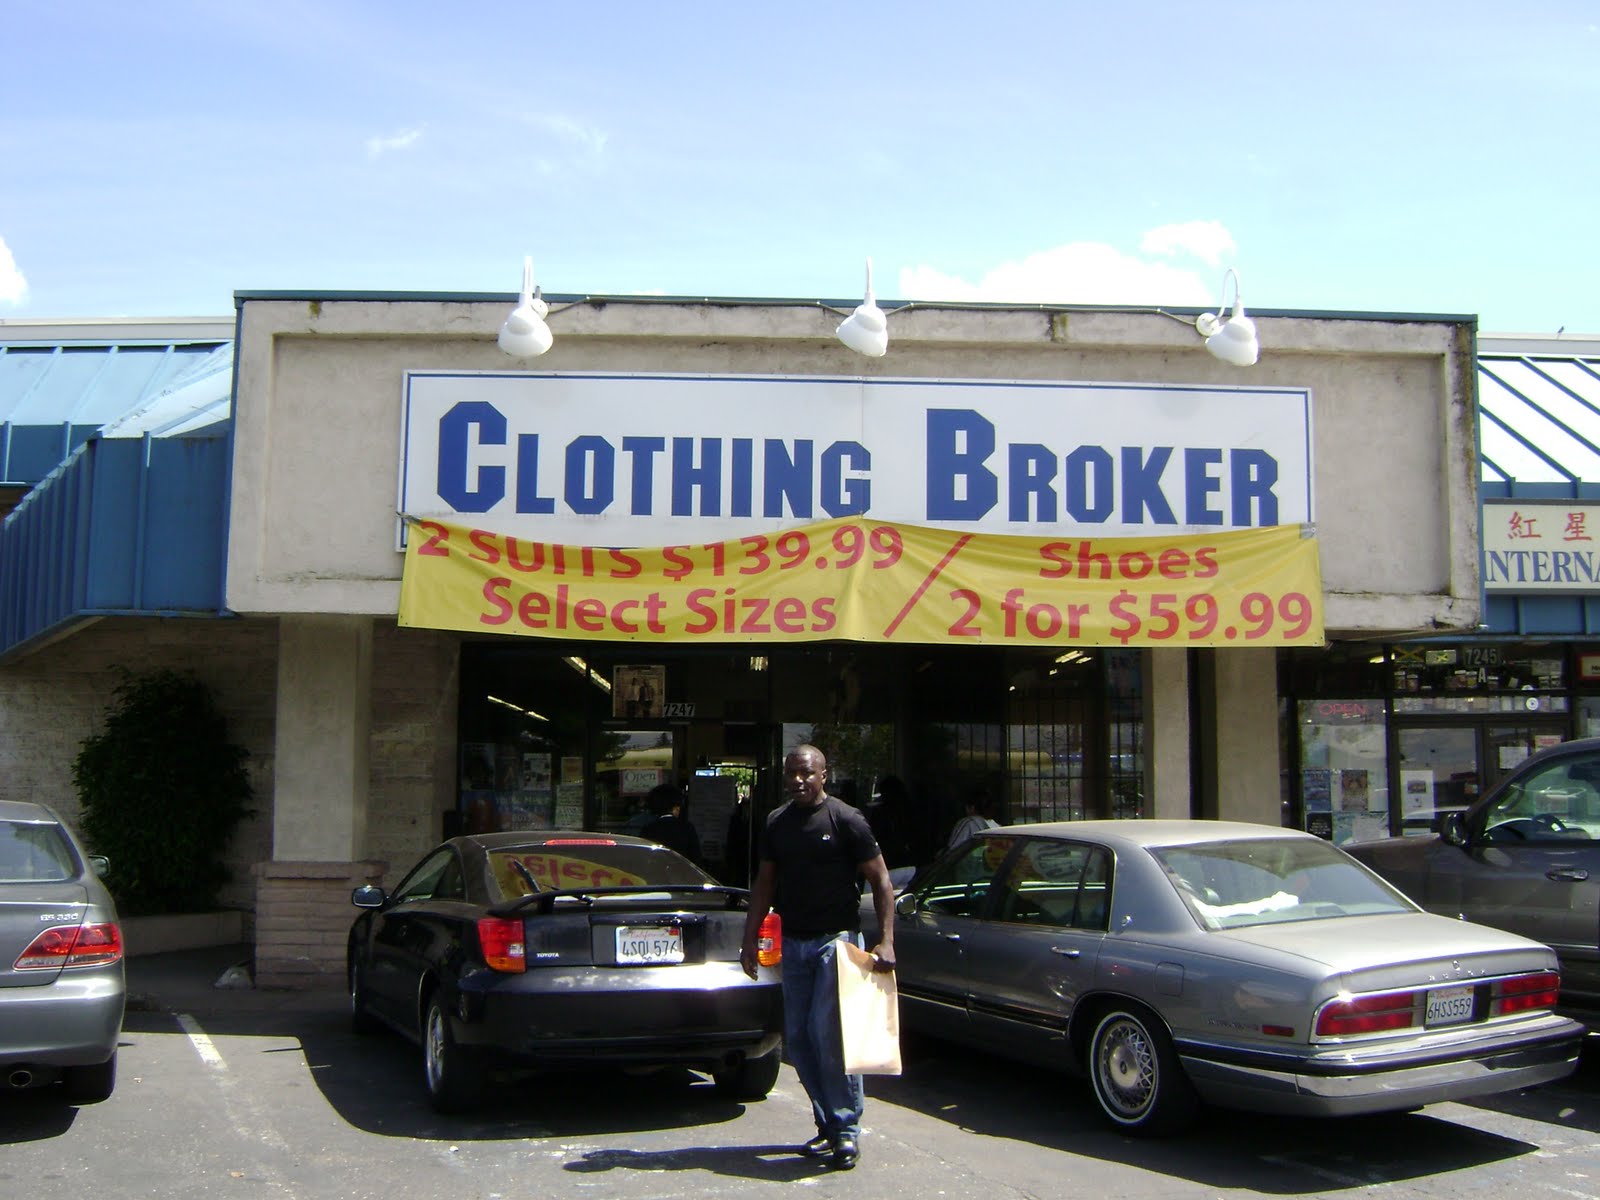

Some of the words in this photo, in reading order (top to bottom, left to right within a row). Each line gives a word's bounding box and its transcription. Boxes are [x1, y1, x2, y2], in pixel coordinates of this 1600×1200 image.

[437, 401, 872, 519] CLOTHING
[926, 408, 1279, 527] BROKER
[1507, 511, 1593, 542] 紅星
[418, 520, 450, 558] 2
[662, 524, 904, 582] $139.99
[1039, 541, 1220, 580] Shoes
[479, 576, 667, 634] Select
[684, 587, 837, 634] Sizes
[948, 588, 982, 637] 2
[1000, 588, 1089, 639] for
[1109, 588, 1313, 645] $59.99
[1465, 648, 1498, 665] 7245
[1478, 667, 1487, 683] A
[663, 703, 694, 716] 7247
[1427, 997, 1472, 1019] 6HSS559
